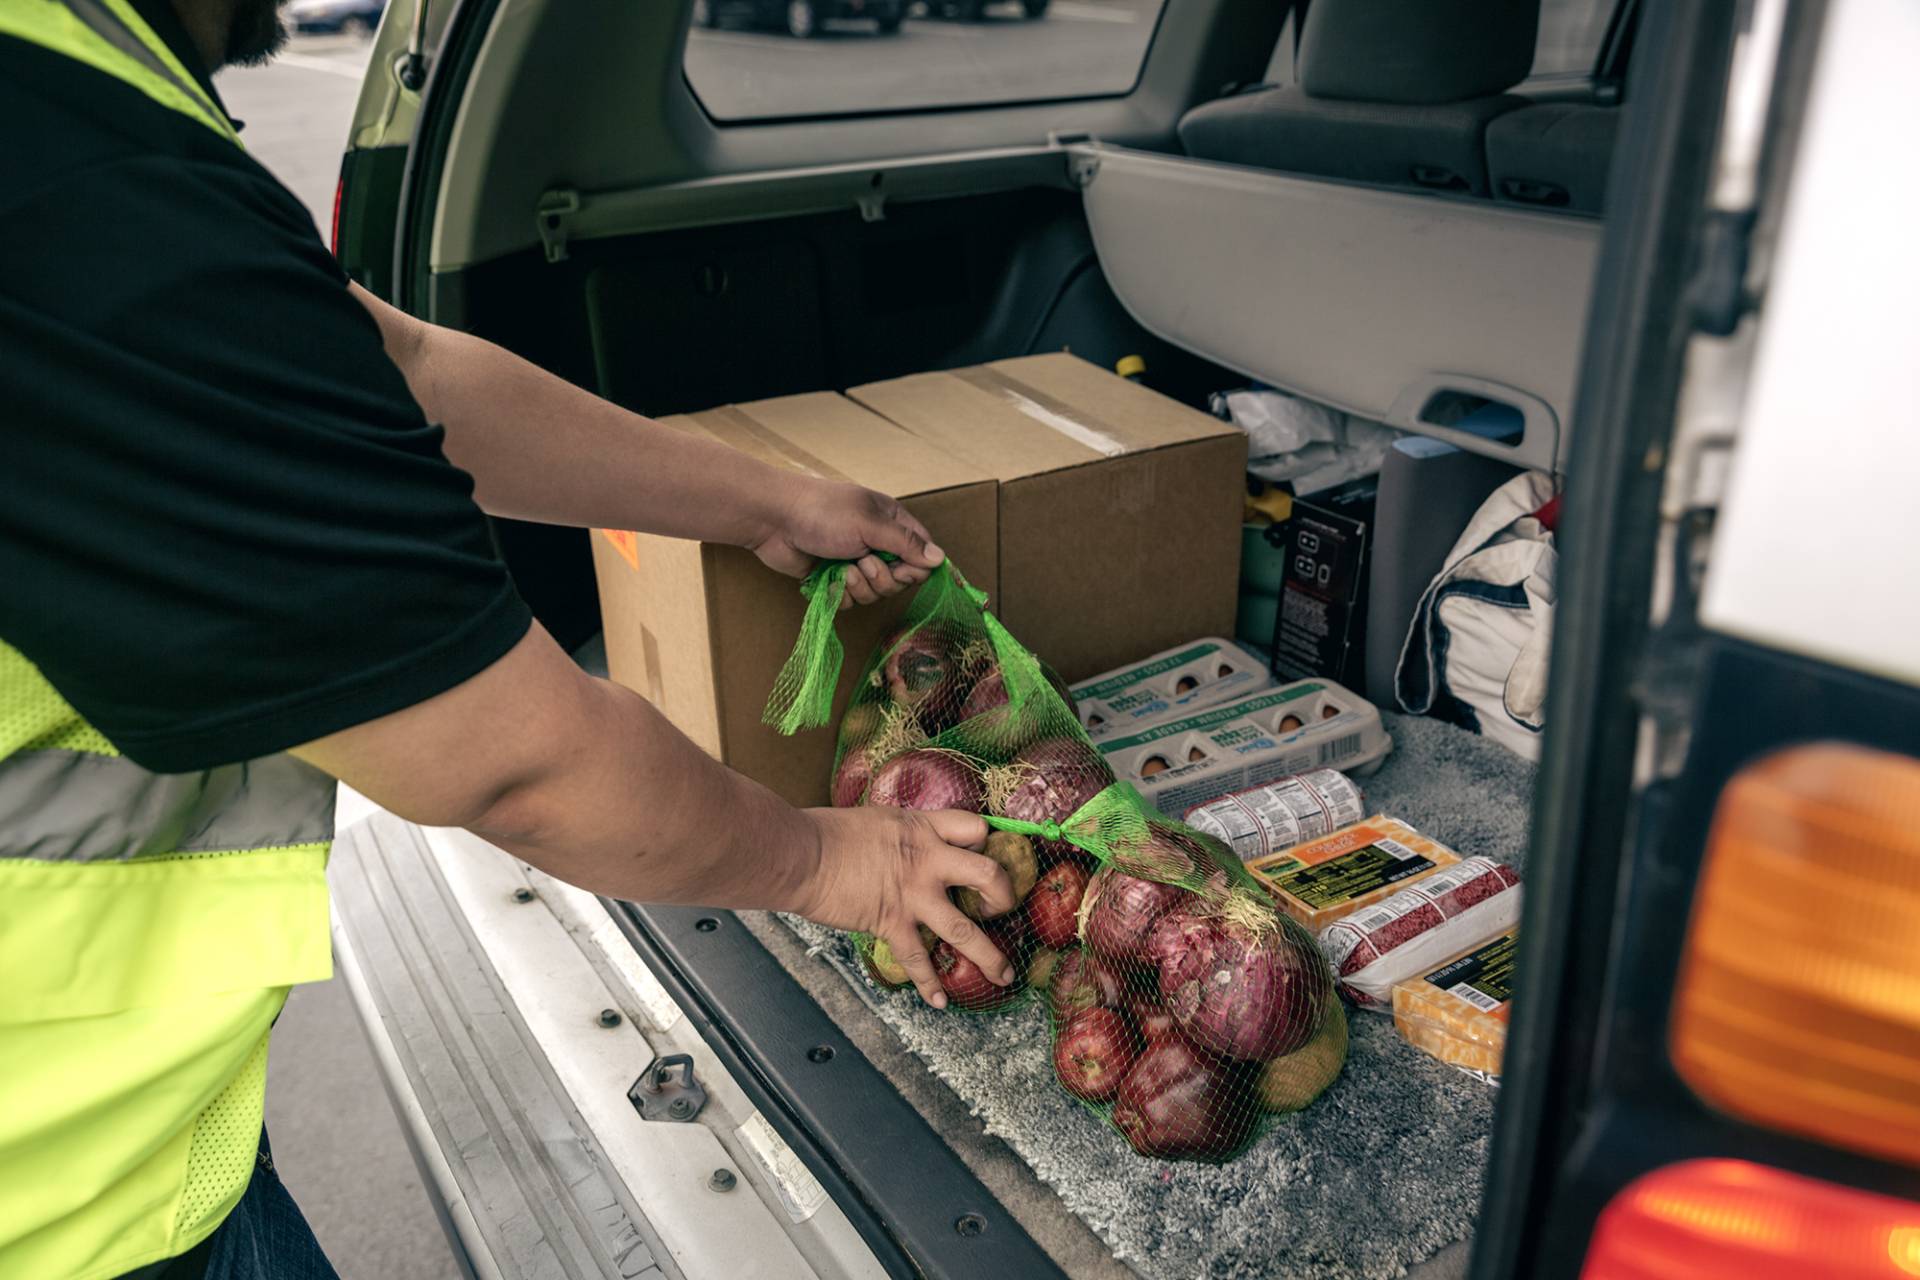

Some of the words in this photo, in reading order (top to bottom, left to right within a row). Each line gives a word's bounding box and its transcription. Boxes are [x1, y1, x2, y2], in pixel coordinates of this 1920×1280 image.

[1245, 697, 1270, 710] EGGS
[1197, 708, 1239, 725] MEDIUM
[1153, 722, 1188, 736] GRADE
